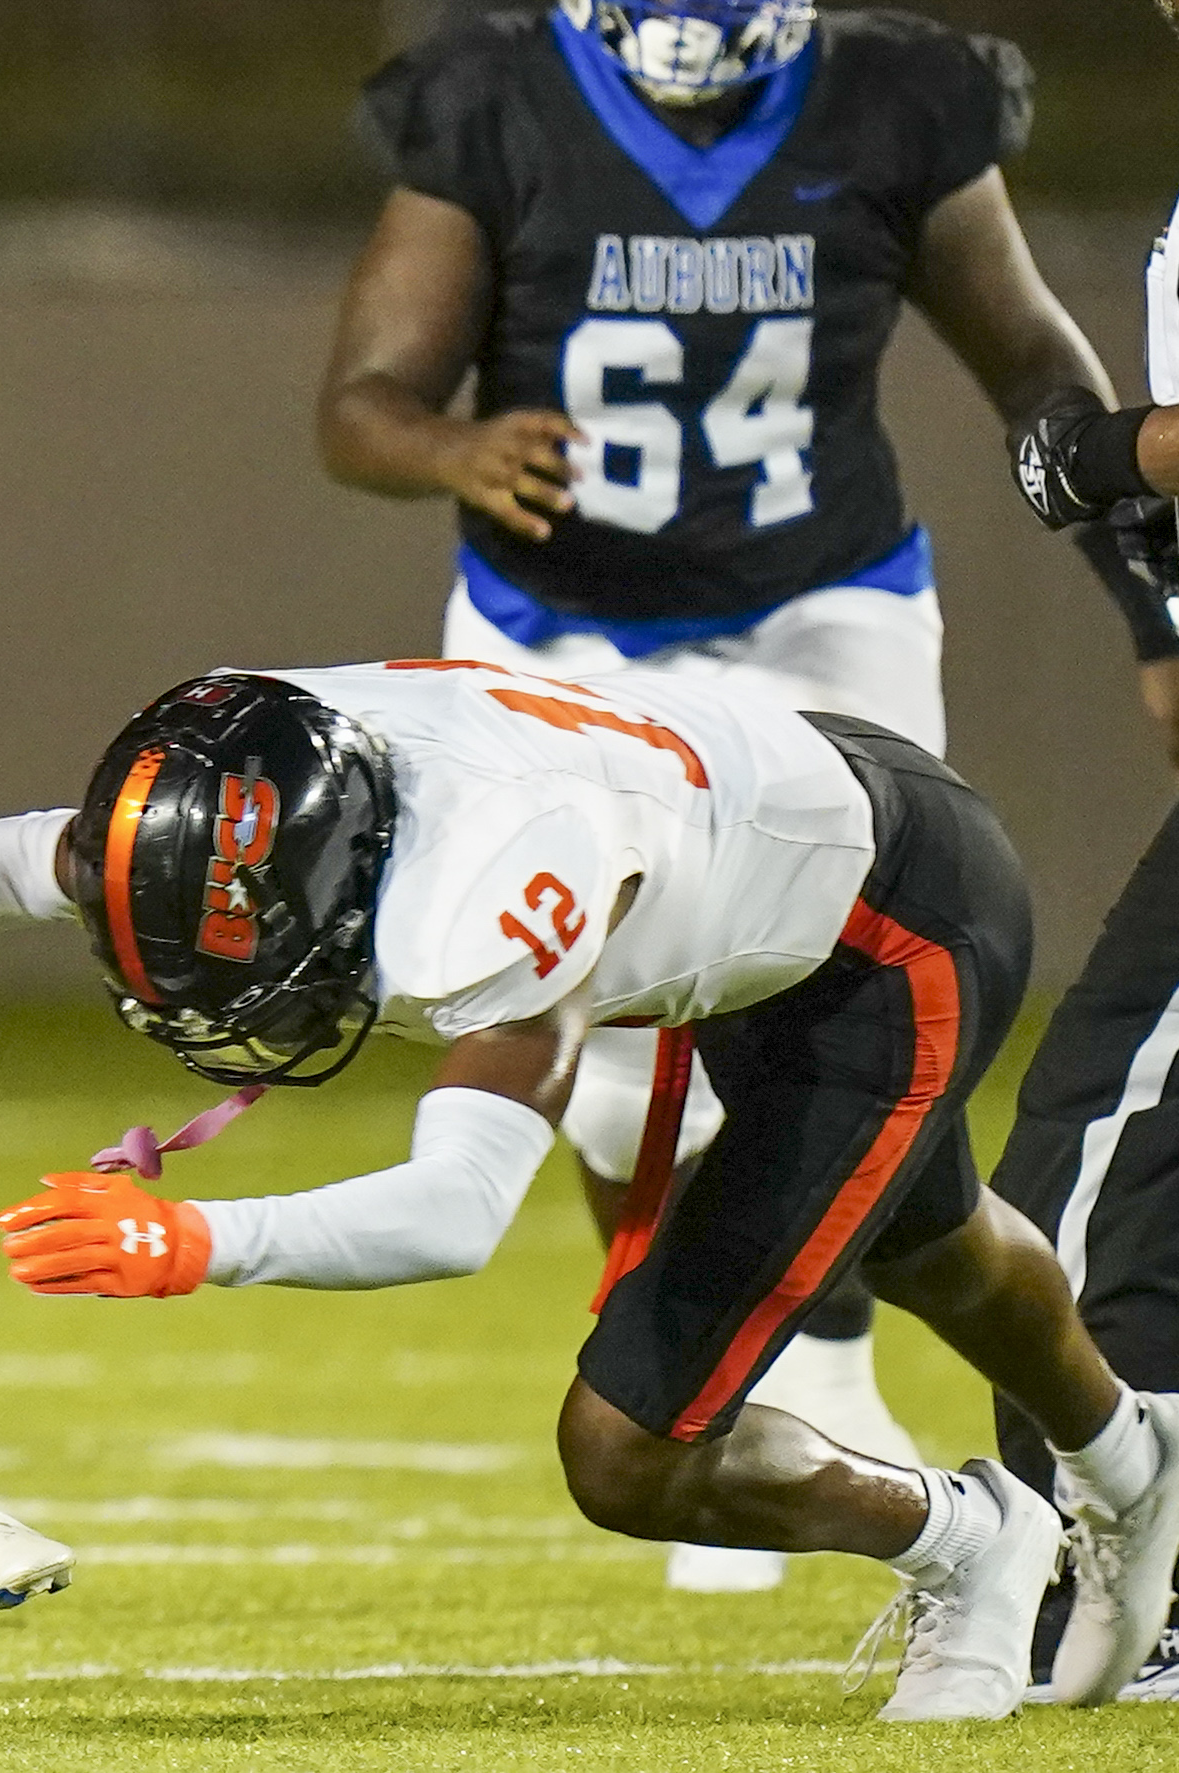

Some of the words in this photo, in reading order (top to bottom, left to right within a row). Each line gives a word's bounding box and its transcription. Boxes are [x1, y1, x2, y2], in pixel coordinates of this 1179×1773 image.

[587, 233, 817, 314] AUBURN
[561, 314, 817, 536] 64
[499, 871, 587, 980] 12
